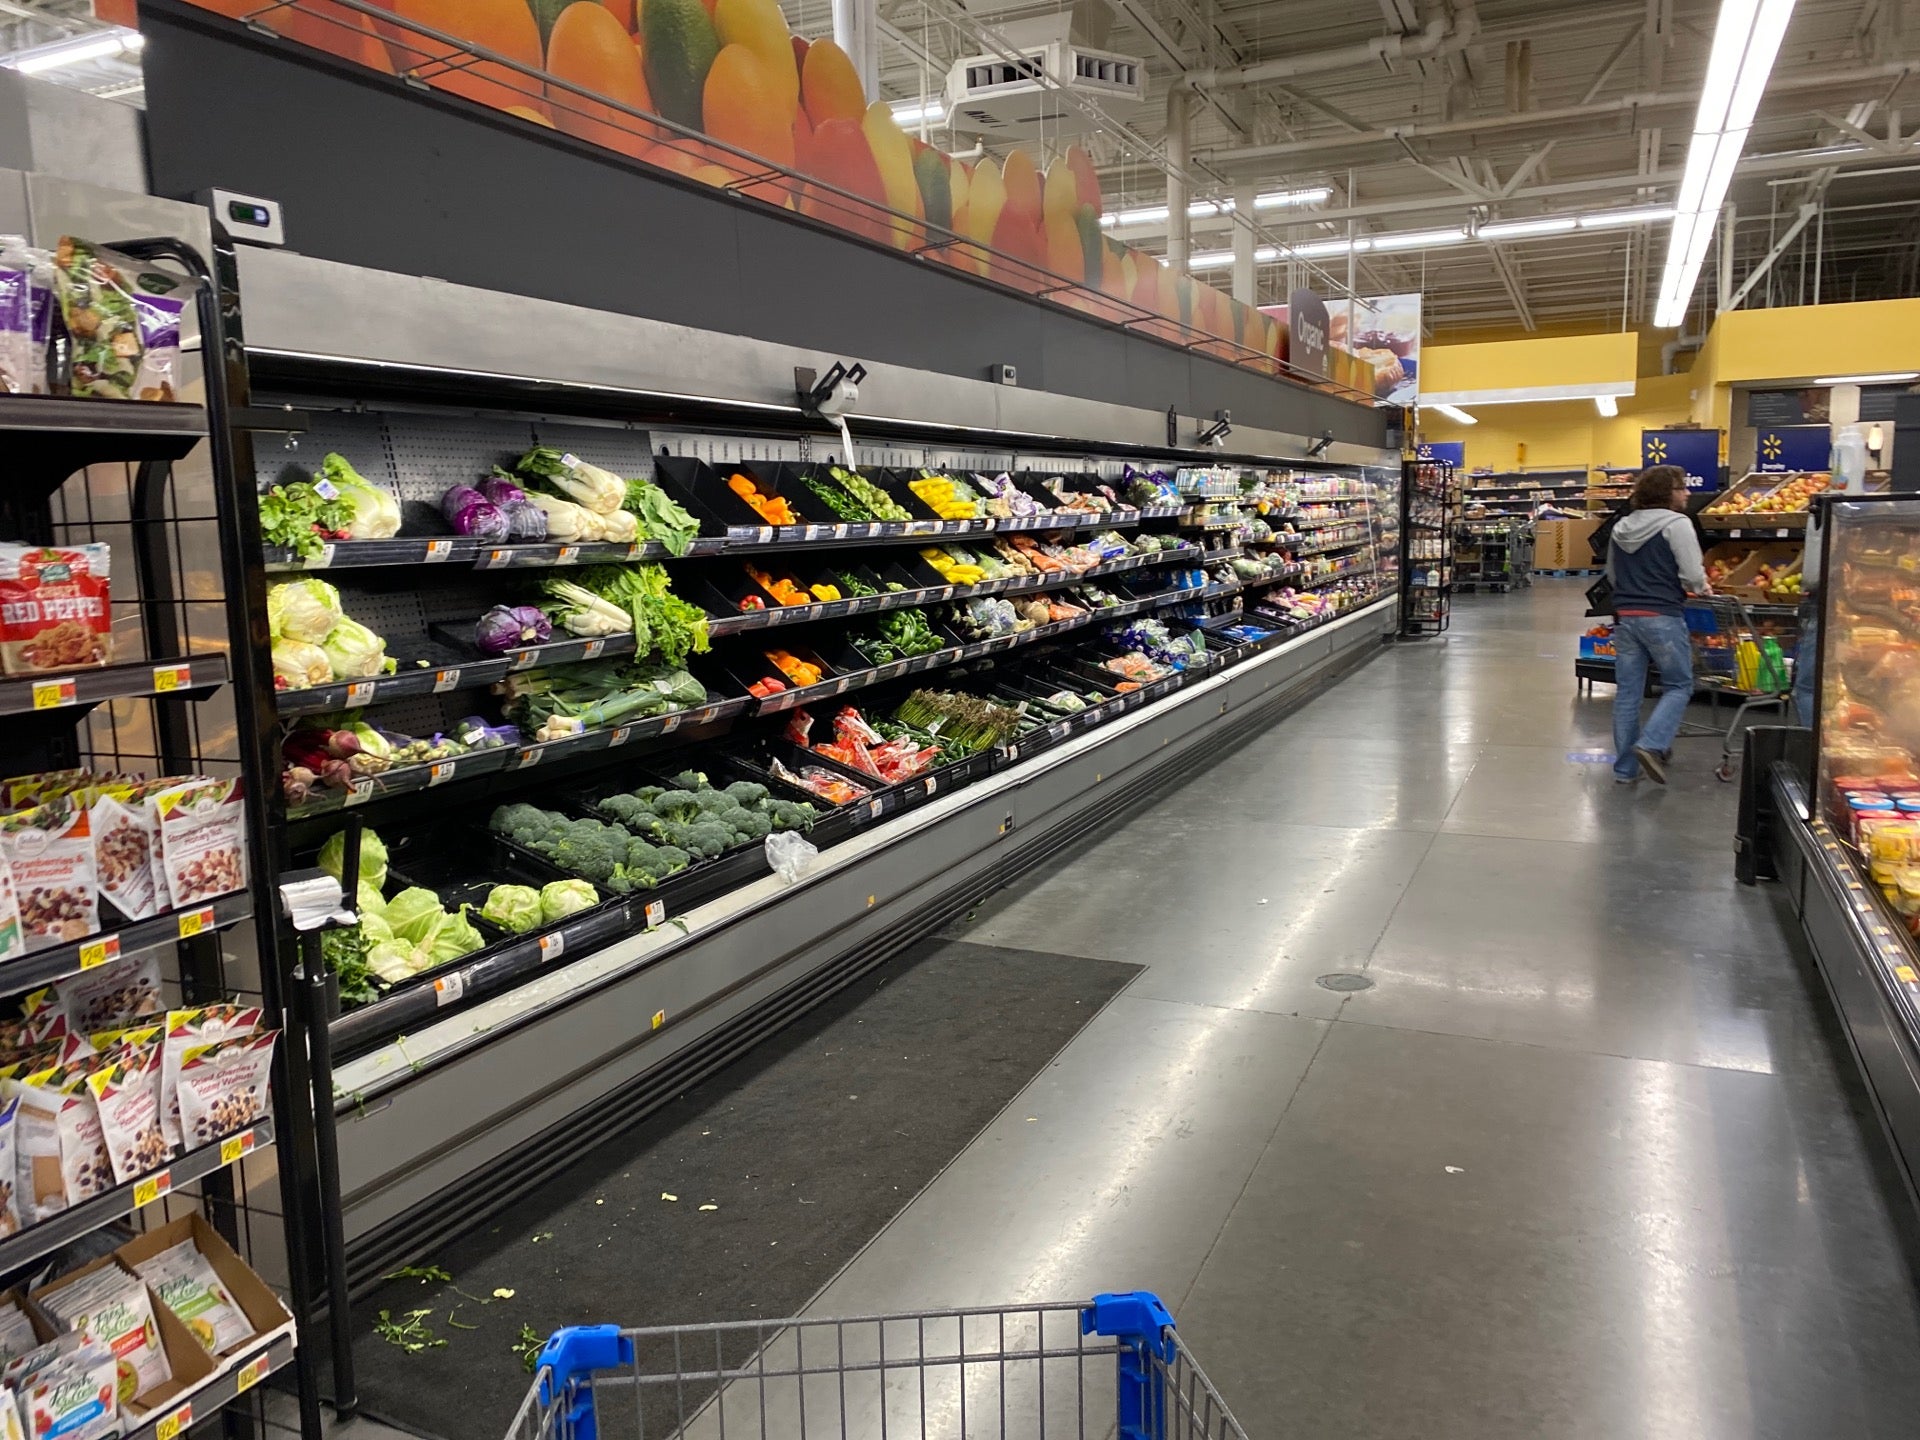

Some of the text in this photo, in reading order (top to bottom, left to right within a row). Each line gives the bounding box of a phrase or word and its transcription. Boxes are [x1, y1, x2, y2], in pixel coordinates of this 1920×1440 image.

[1297, 311, 1325, 355] Organic
[1, 601, 40, 625] RED
[1593, 642, 1617, 656] halo
[11, 857, 74, 871] Cranberries
[25, 866, 74, 879] Almonds
[191, 1073, 215, 1088] Dried
[216, 1064, 252, 1079] Cherries
[221, 1072, 255, 1087] Walnuts
[156, 1273, 195, 1300] Fresh
[93, 1302, 131, 1334] Fresh
[49, 1371, 94, 1408] Fresh
